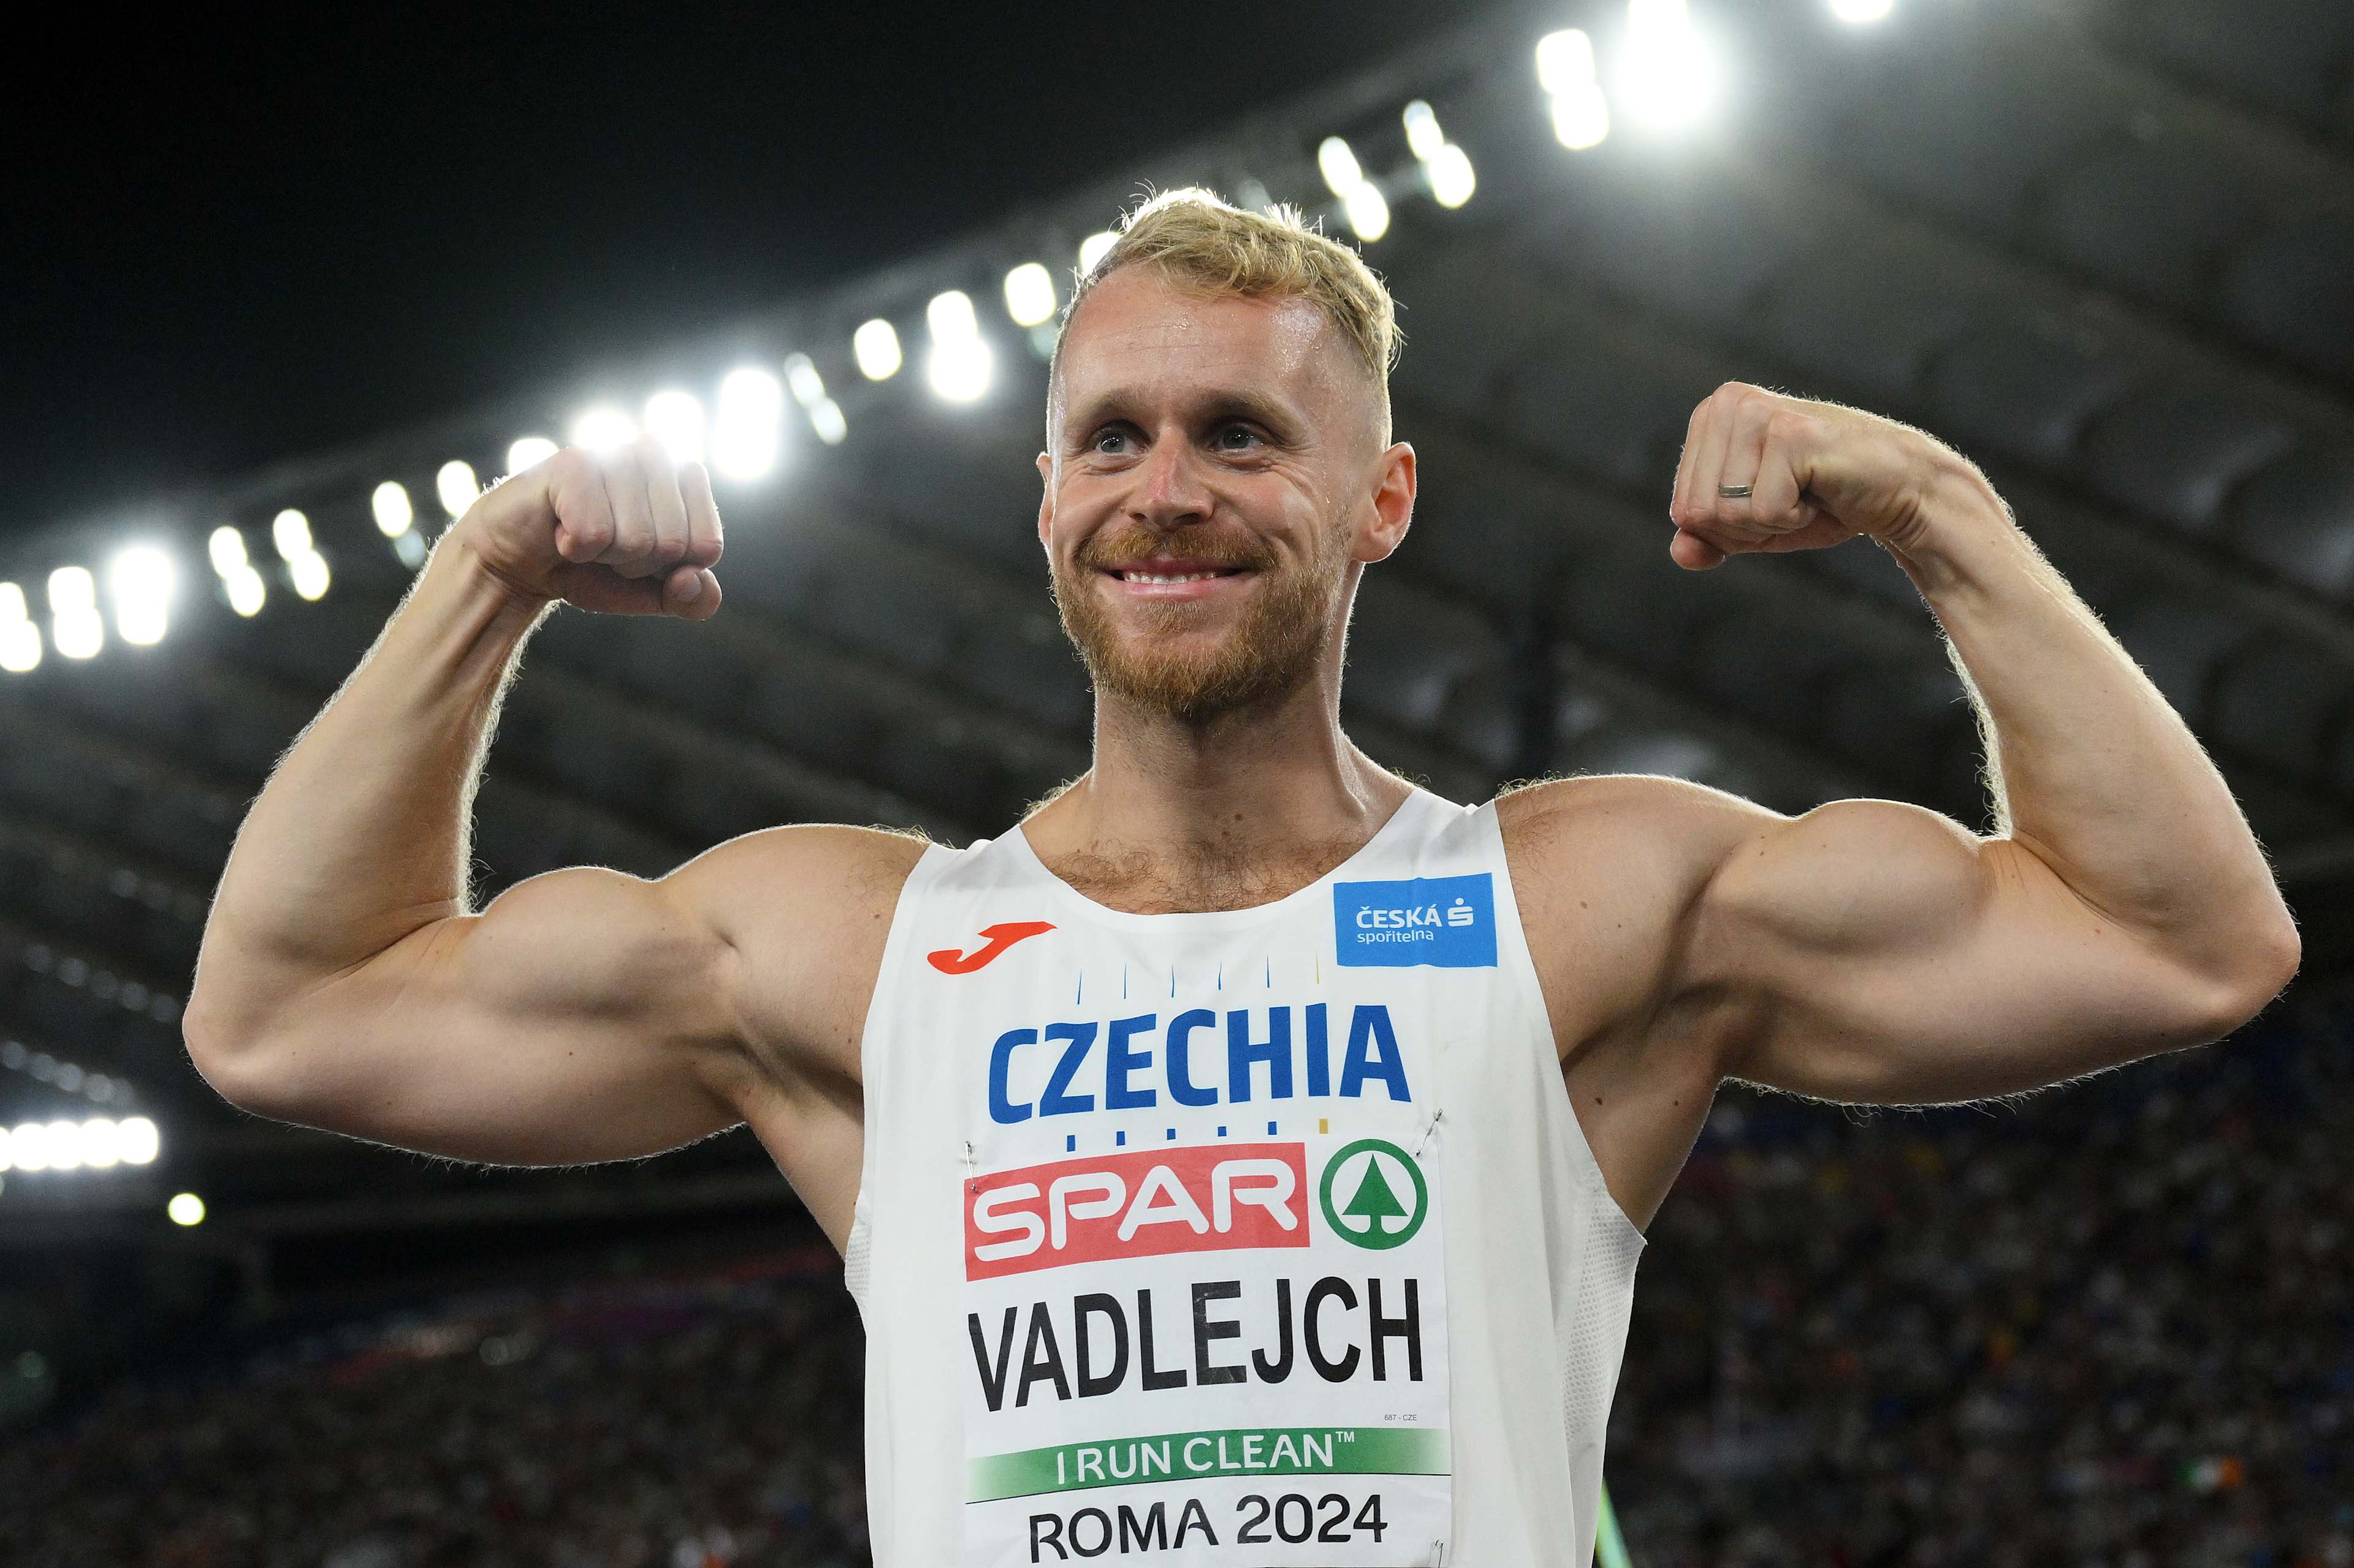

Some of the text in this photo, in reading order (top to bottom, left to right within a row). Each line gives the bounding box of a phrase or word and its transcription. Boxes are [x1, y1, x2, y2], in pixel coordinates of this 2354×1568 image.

[1356, 904, 1442, 929] ČESKÁ
[1357, 929, 1434, 945] spořitelna
[988, 1003, 1412, 1124] CZECHIA
[973, 1159, 1298, 1262] SPAR
[968, 1277, 1423, 1412] VADLEJCH
[1057, 1452, 1065, 1485] I
[1077, 1441, 1171, 1483] RUN
[1029, 1493, 1388, 1564] ROMA 2024
